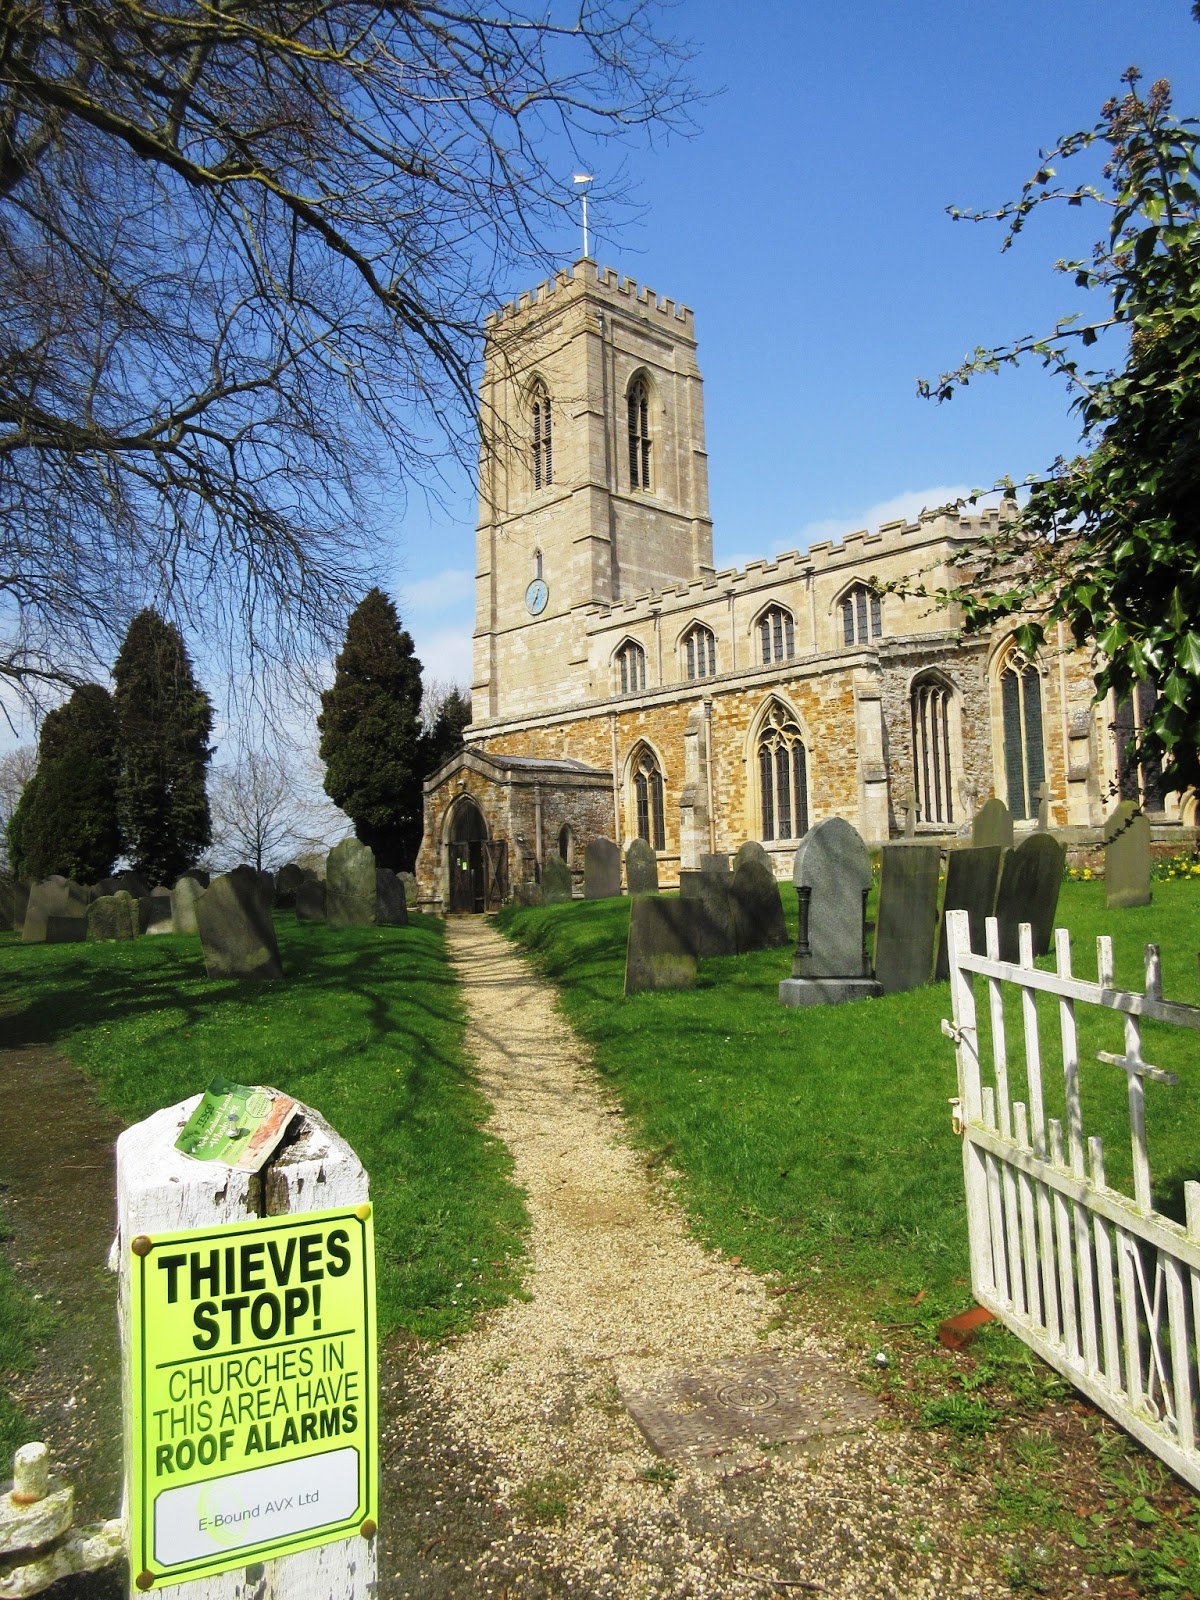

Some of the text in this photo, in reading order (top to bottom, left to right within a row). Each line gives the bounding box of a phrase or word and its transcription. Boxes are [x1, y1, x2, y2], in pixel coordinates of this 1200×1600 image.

[196, 1103, 213, 1126] TESCO
[197, 1136, 209, 1150] New
[207, 1111, 223, 1136] Zealand
[211, 1121, 229, 1146] Whole
[158, 1230, 351, 1303] THIEVES
[193, 1284, 321, 1350] STOP!
[169, 1341, 344, 1402] CHURCHES IN
[153, 1372, 358, 1442] THIS AREA HAVE
[156, 1404, 358, 1476] ROOF ALARMS
[198, 1490, 319, 1531] E-Bound AVX Ltd
